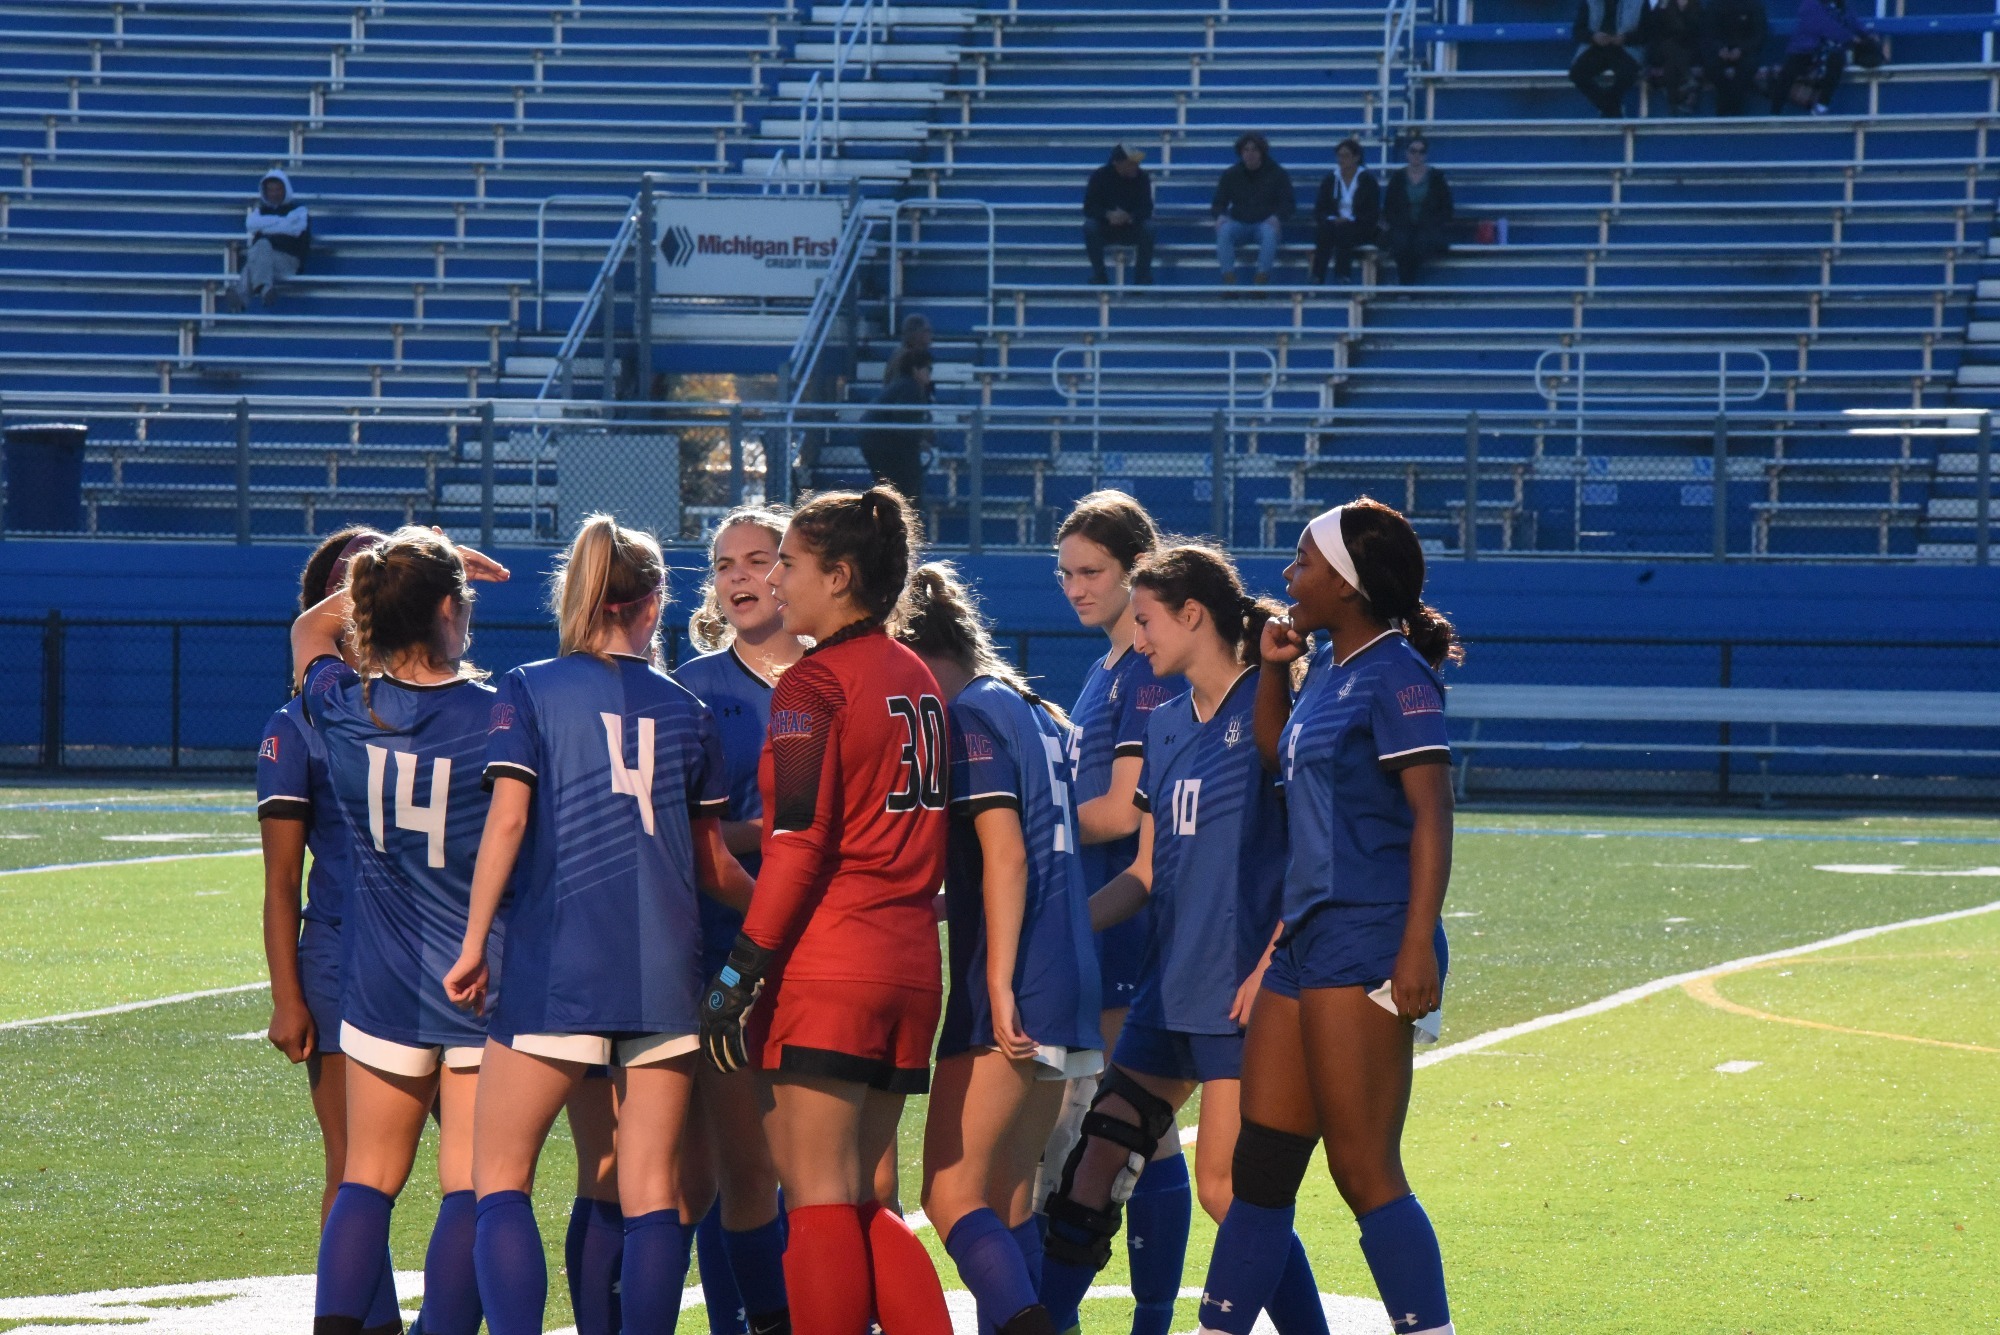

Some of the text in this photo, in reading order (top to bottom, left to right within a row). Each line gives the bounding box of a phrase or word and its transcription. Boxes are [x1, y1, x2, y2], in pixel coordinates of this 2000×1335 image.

[697, 235, 838, 260] Michigan First
[365, 743, 451, 868] 14
[599, 711, 655, 836] 4
[886, 694, 946, 812] 30
[1172, 778, 1202, 835] 10
